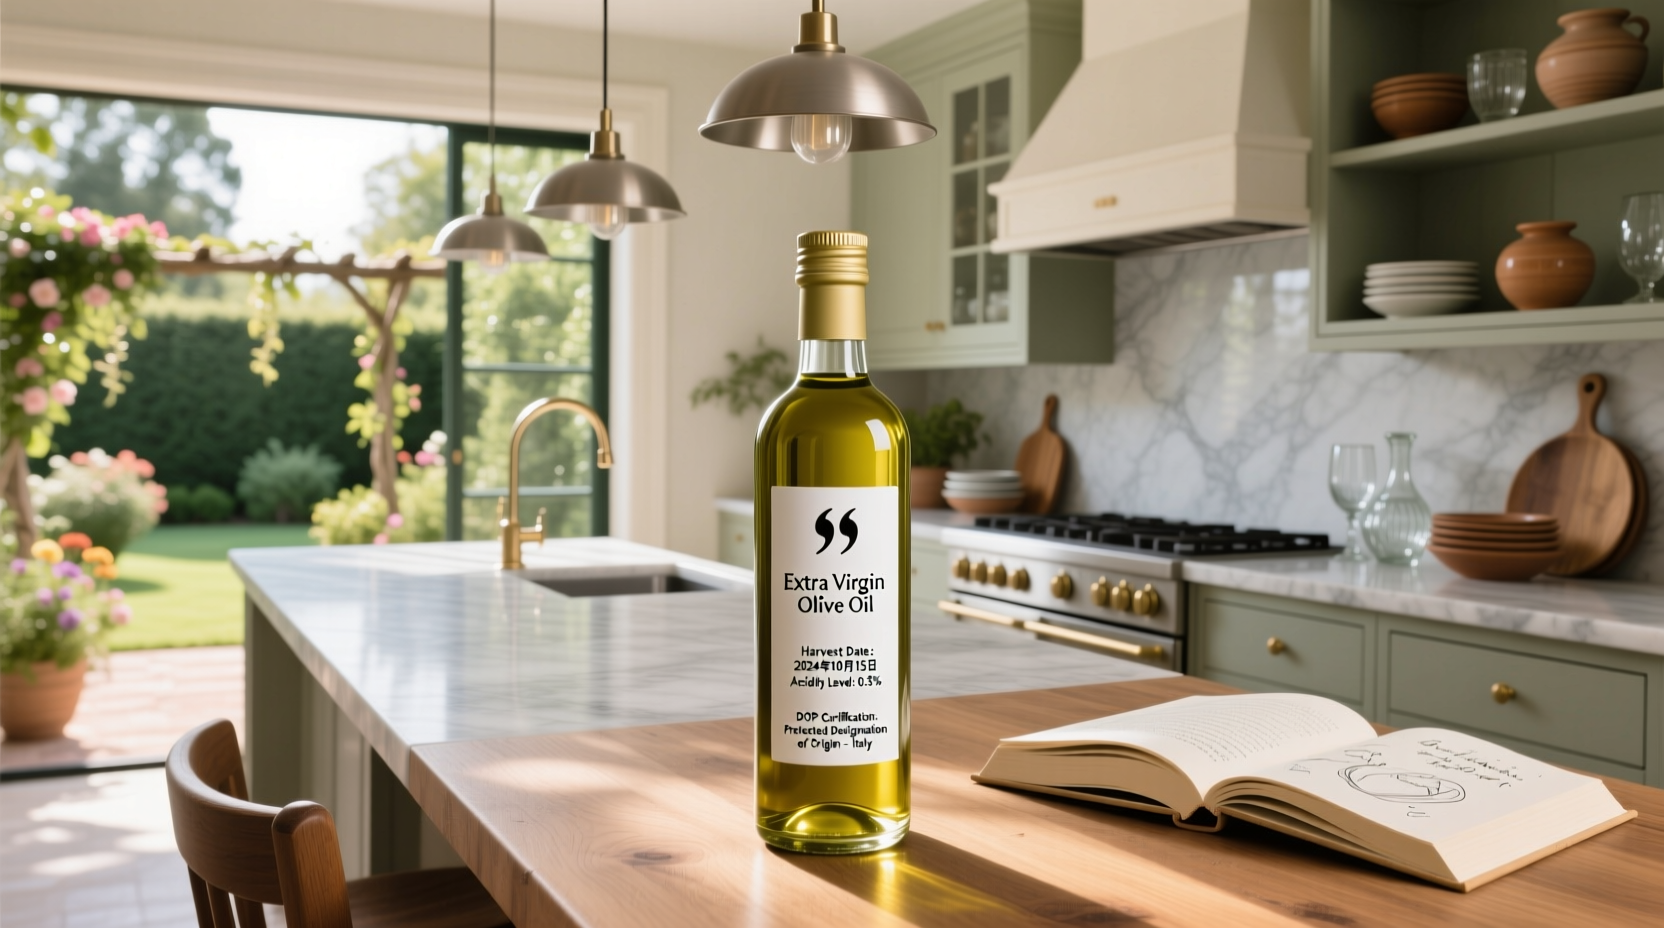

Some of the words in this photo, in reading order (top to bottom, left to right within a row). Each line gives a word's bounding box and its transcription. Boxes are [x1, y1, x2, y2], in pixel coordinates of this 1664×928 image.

[784, 573, 829, 591] Extra
[832, 573, 885, 595] Virgin
[797, 595, 844, 613] Olive
[849, 595, 874, 613] Oil
[801, 645, 843, 657] Harvest
[846, 646, 874, 657] Date:
[796, 711, 819, 722] DOP
[797, 738, 809, 749] of
[852, 737, 873, 751] Italy
